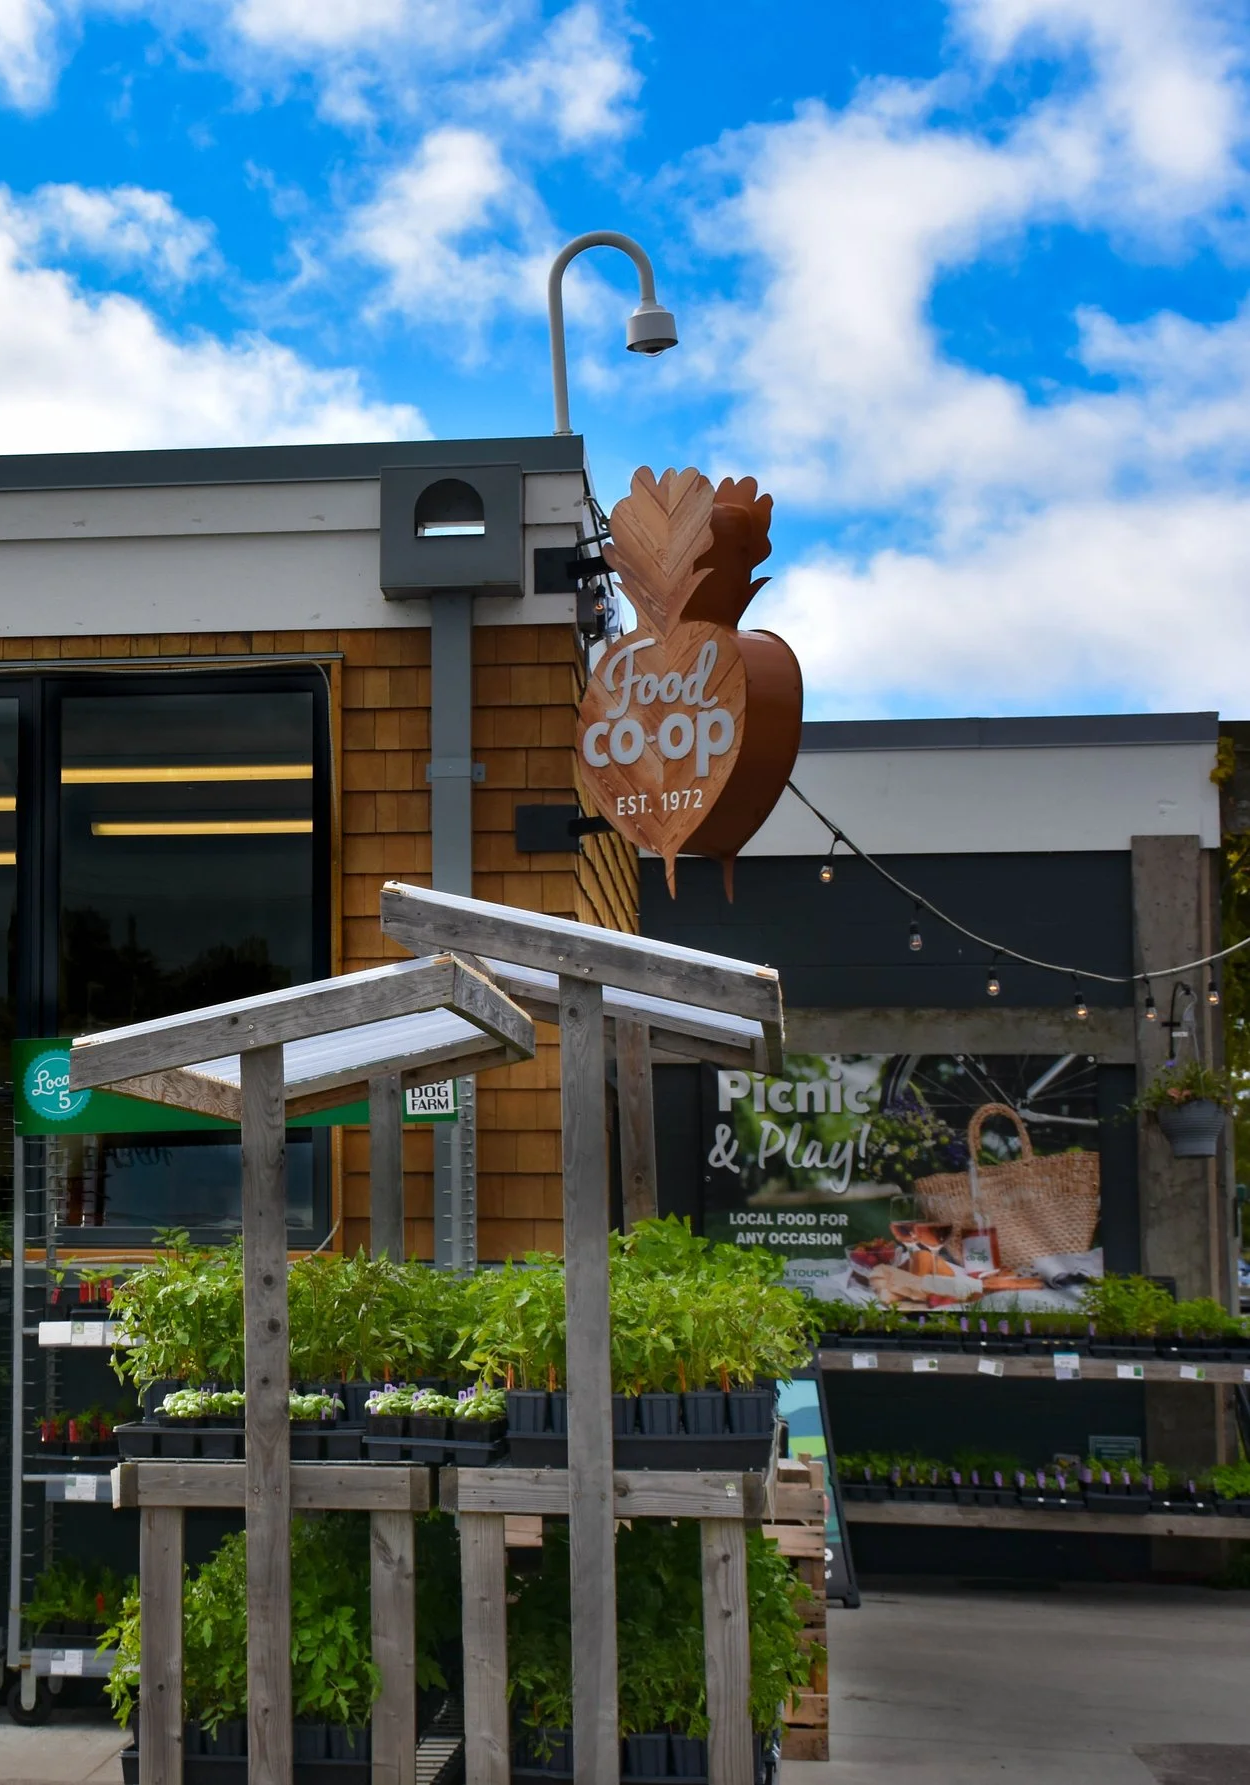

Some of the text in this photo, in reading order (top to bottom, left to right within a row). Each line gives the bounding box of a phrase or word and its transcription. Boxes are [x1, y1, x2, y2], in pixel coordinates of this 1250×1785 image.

[604, 637, 719, 720] Food
[582, 708, 735, 777] co-op
[617, 788, 703, 816] EST. 1972
[32, 1070, 70, 1096] Loca
[411, 1086, 448, 1098] DOG
[717, 1063, 871, 1114] Picnic
[59, 1089, 71, 1109] 5
[411, 1098, 449, 1111] FARM
[707, 1120, 872, 1194] & Play!
[730, 1213, 849, 1226] LOCAL FOOD FOR
[736, 1232, 843, 1245] ANY OCCASION
[792, 1269, 829, 1278] TOUCH
